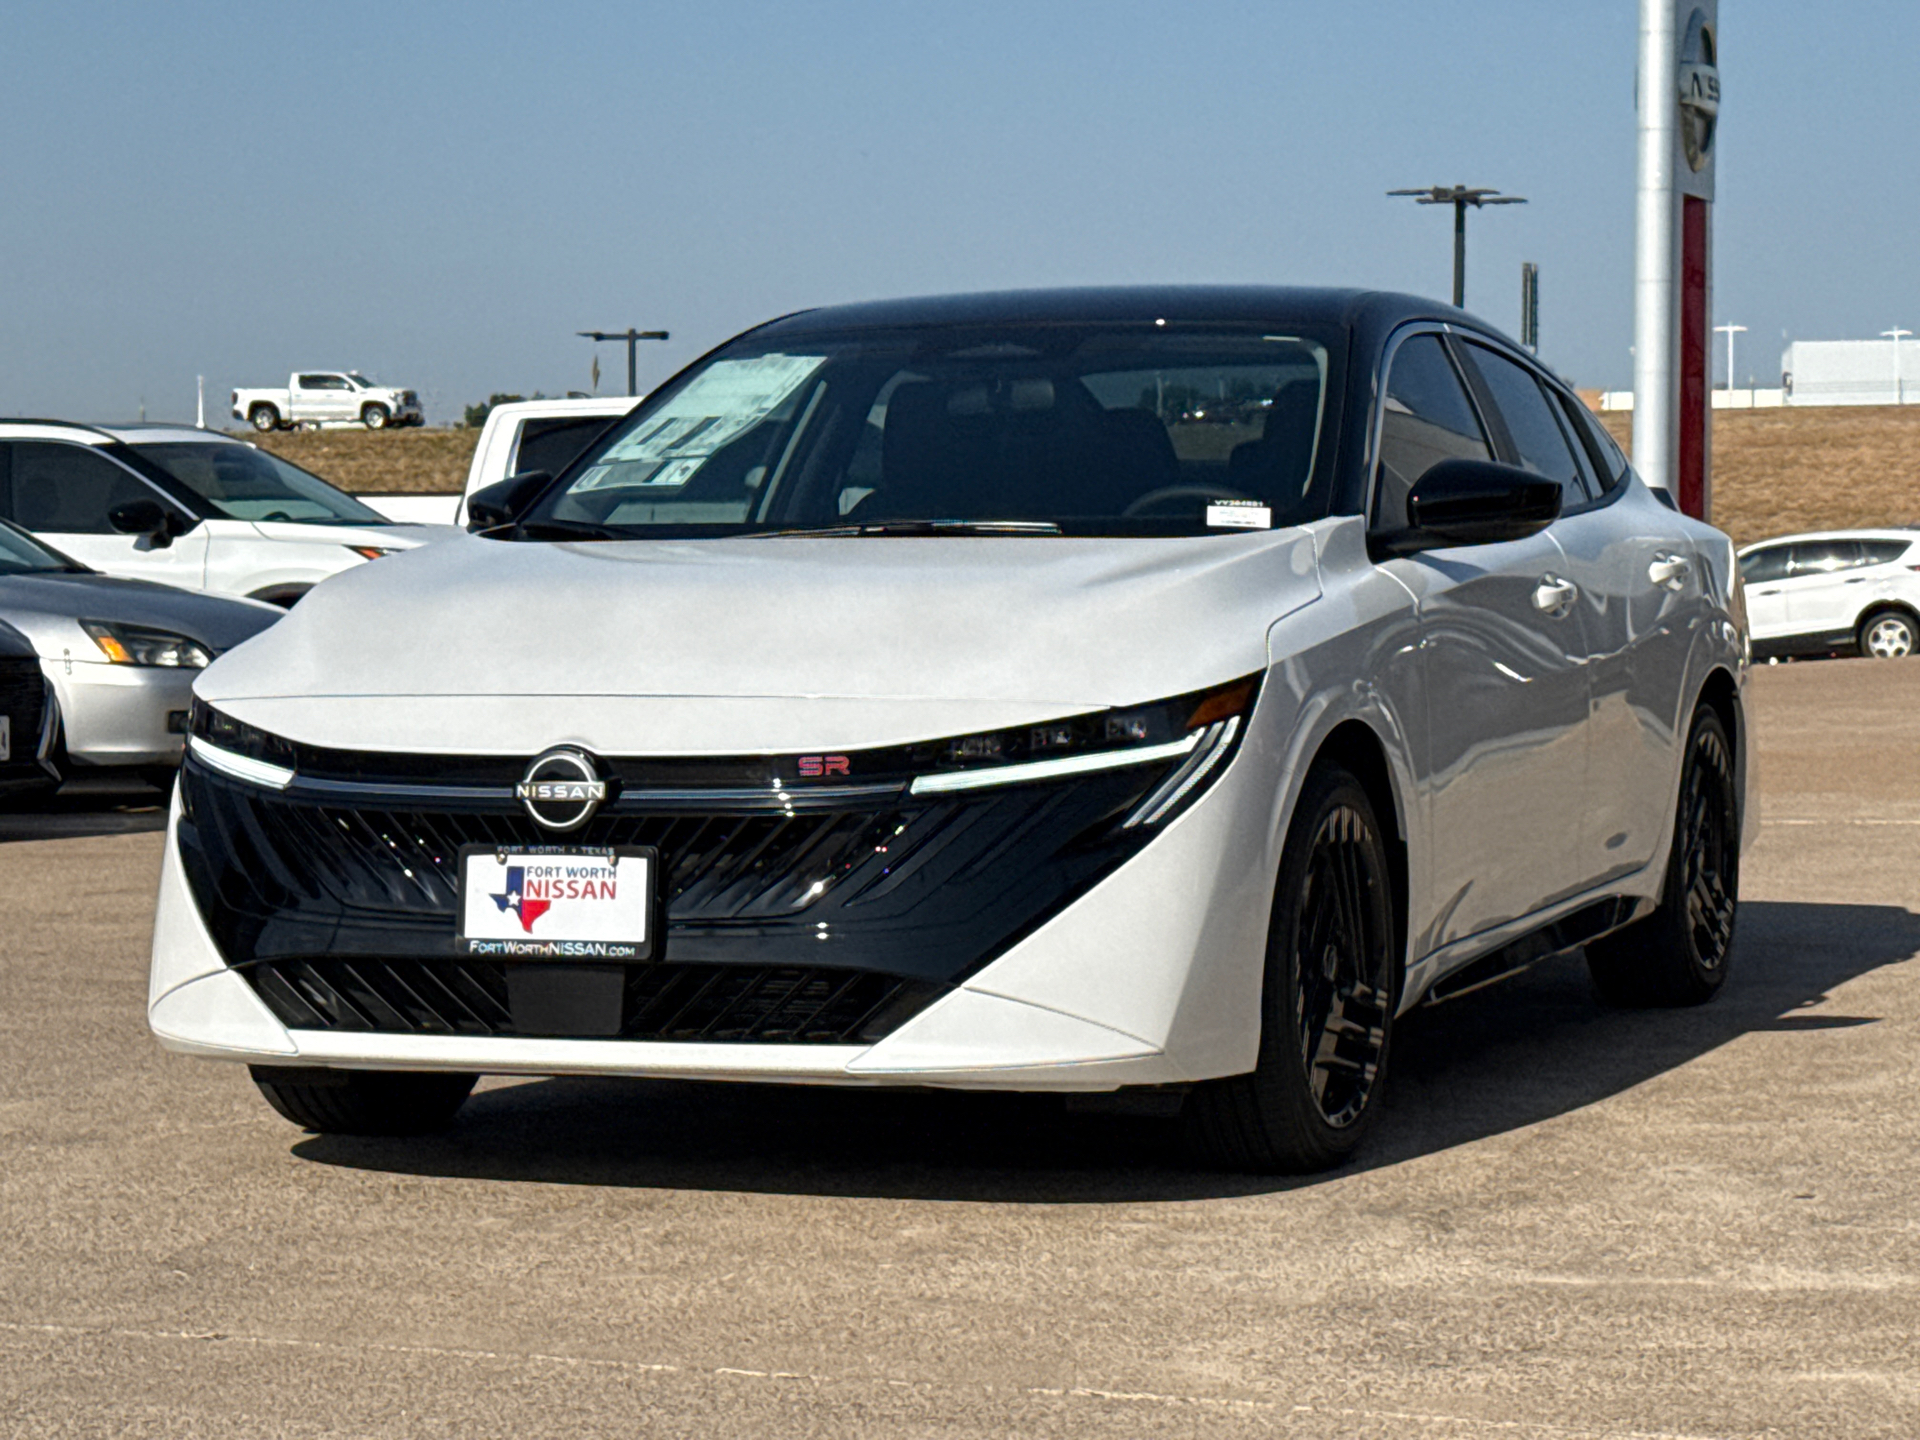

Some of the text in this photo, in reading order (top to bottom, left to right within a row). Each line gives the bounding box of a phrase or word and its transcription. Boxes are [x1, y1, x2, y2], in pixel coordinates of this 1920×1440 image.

[798, 756, 851, 776] SR
[516, 785, 603, 798] NISSAN
[497, 845, 615, 855] FORT WORTH TEXAS
[526, 866, 617, 879] FORT WORTH
[526, 879, 617, 900] NISSAN
